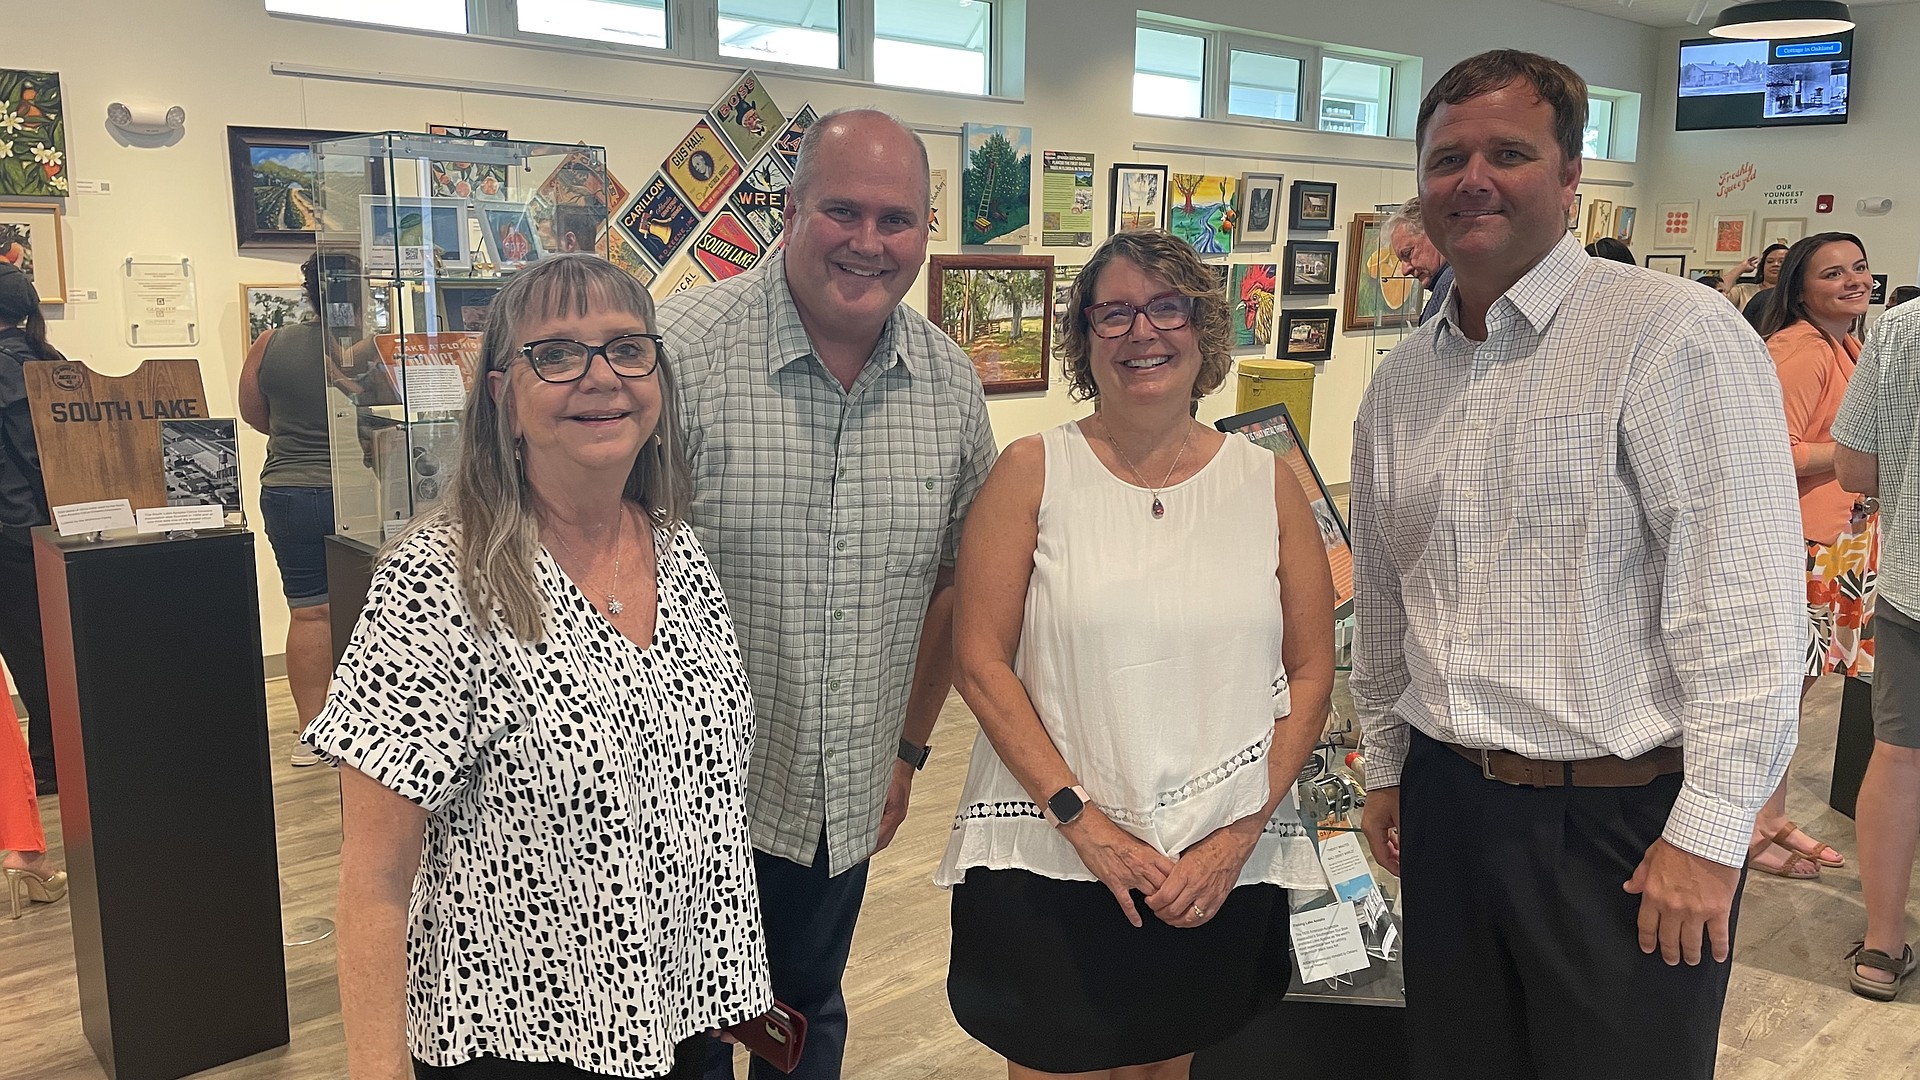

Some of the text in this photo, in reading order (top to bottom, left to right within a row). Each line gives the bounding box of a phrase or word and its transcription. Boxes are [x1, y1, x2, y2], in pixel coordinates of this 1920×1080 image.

[718, 77, 755, 119] BOSS
[671, 147, 689, 167] GUS
[685, 131, 704, 151] HALL
[1716, 169, 1757, 198] Squeezed
[1718, 162, 1754, 186] Freshly
[624, 179, 665, 227] CARILLON
[738, 191, 787, 206] WRE
[1763, 190, 1804, 198] YOUNGEST
[699, 235, 732, 260] SOUTH
[729, 249, 756, 268] LAKE
[51, 398, 200, 423] SOUTH LAKE
